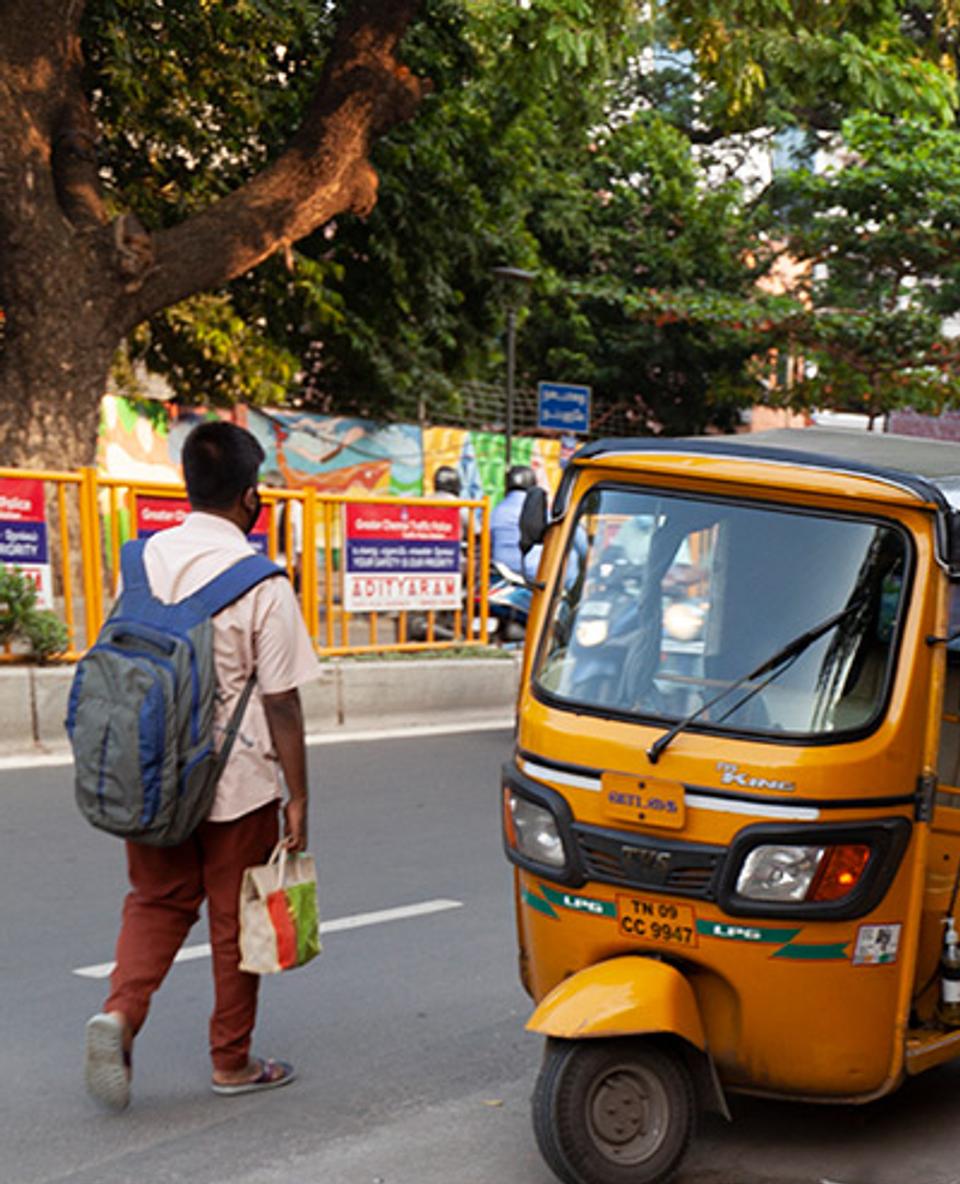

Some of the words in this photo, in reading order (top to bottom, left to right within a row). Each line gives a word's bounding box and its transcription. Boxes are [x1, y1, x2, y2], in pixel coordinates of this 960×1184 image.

[352, 576, 455, 596] ADITYARAM
[563, 895, 604, 914] LPG
[632, 900, 654, 917] TN
[659, 903, 678, 919] 09
[621, 916, 646, 935] CC
[650, 921, 693, 942] 9947
[713, 925, 761, 940] LPG
